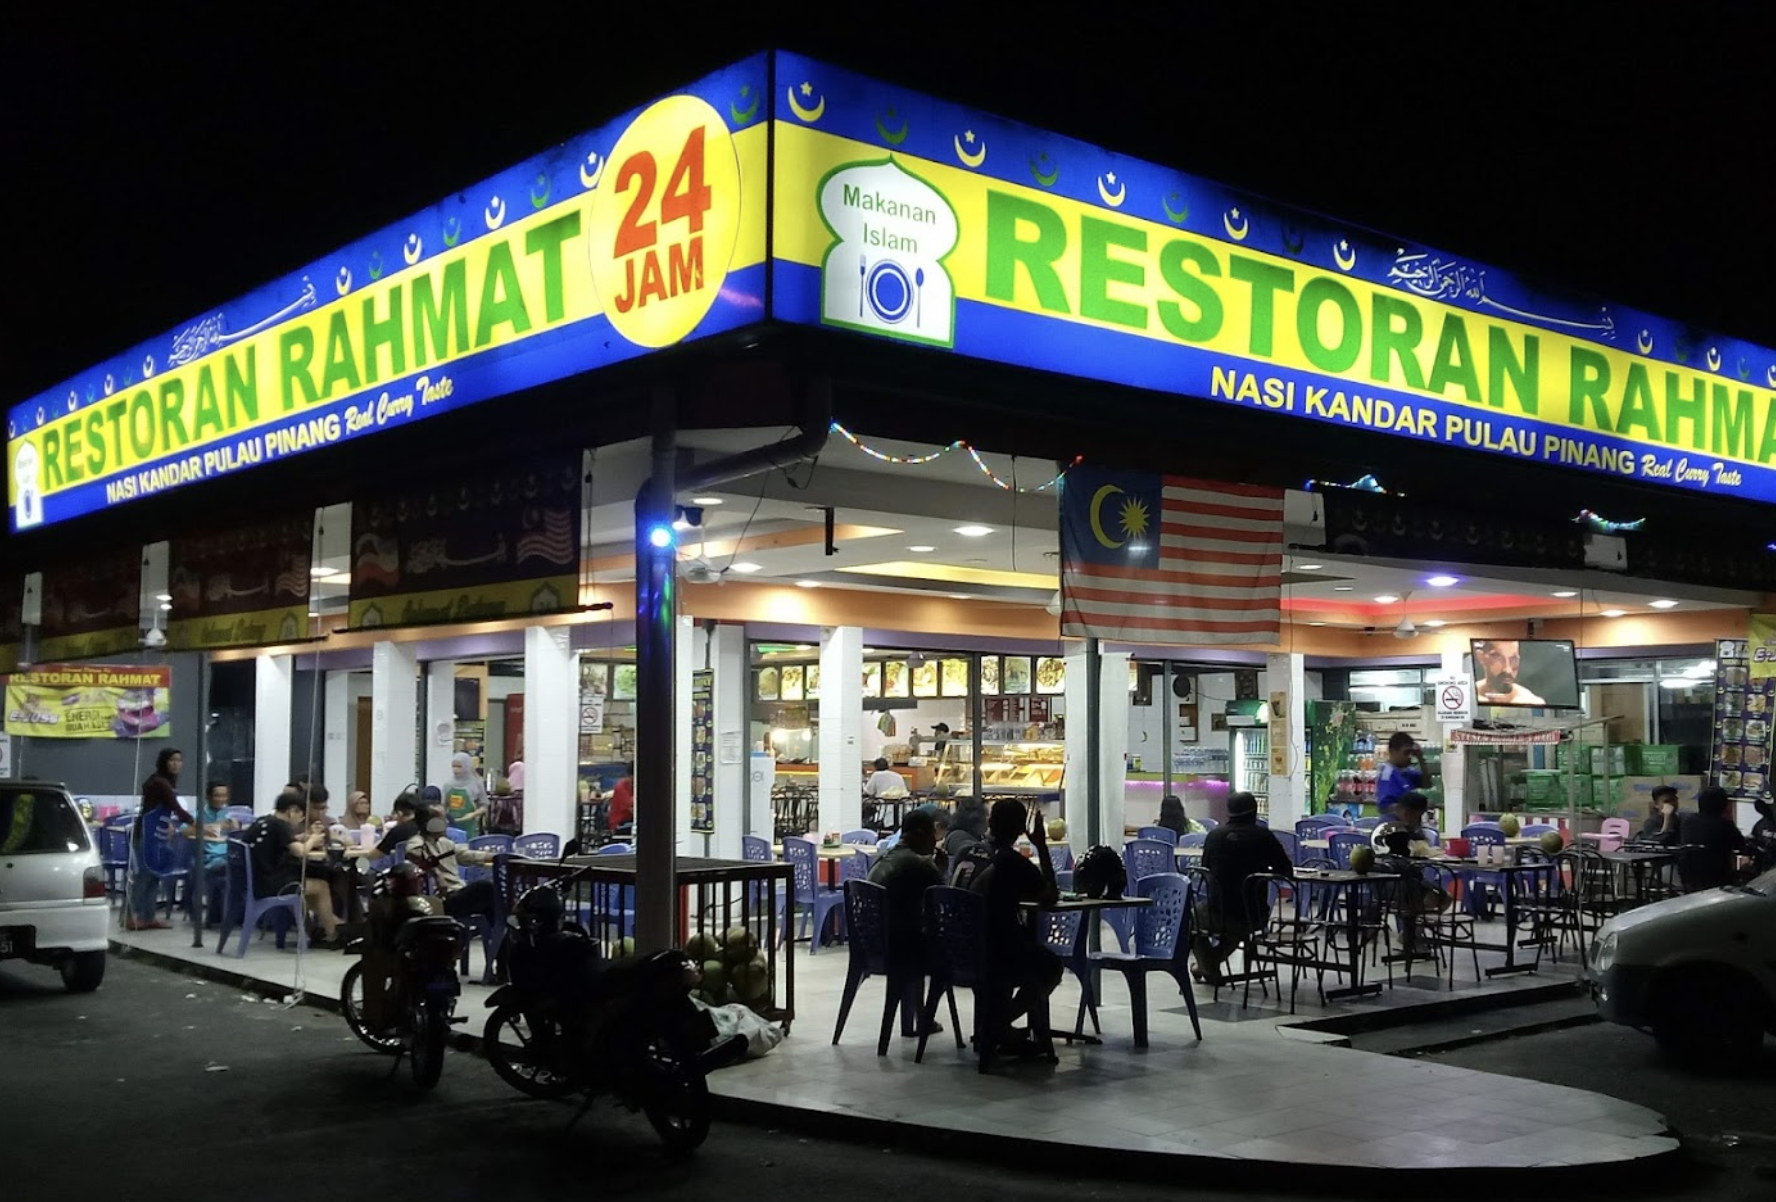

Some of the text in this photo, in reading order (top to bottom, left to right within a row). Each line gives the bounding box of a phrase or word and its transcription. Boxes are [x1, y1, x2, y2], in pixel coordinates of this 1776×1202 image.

[613, 125, 711, 259] 24
[843, 184, 936, 225] Makanan
[863, 222, 918, 254] Islam
[613, 235, 704, 314] JAM
[985, 188, 1539, 416] RESTORAN
[43, 209, 582, 490] RESTORAN RAHMAT
[106, 376, 454, 504] NASI KANDAR PULAU PINANG Real Curry Taste
[1211, 366, 1742, 487] NASI KANDAR PULAU PINANG Real Curry Taste
[9, 672, 161, 685] RESTORAN RAHMAT
